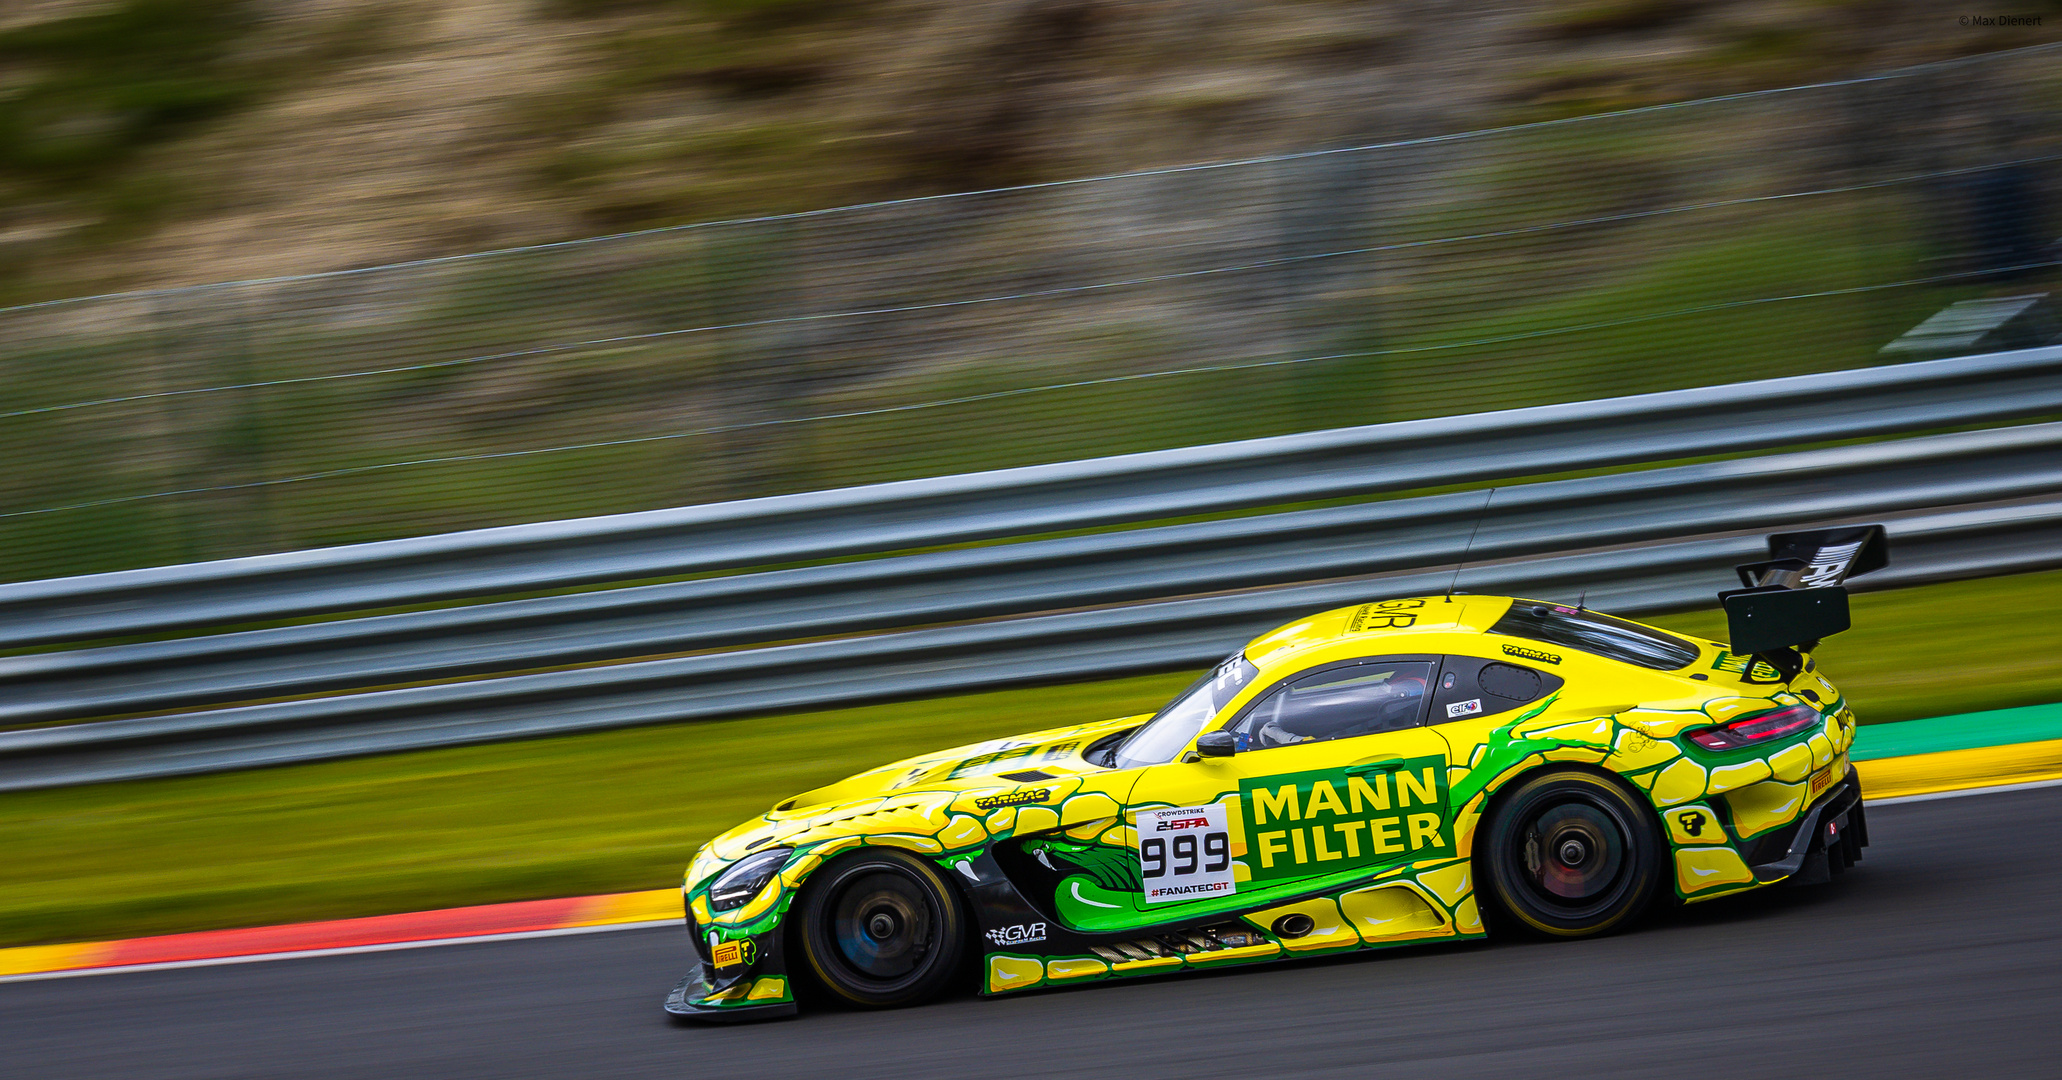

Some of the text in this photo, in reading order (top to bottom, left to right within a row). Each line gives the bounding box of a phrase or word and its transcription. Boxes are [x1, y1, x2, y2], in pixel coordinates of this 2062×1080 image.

[1502, 644, 1561, 664] TARMAC
[1450, 703, 1469, 715] elf
[1811, 768, 1832, 795] PIRELLI
[975, 789, 1048, 808] TARMAC
[1251, 766, 1438, 825] MANN
[1157, 808, 1205, 818] CROWDSTRIKE
[1257, 812, 1446, 869] FILTER
[1141, 831, 1230, 879] 999
[1151, 882, 1229, 897] #FANATECGT
[714, 945, 738, 964] PIRELLI
